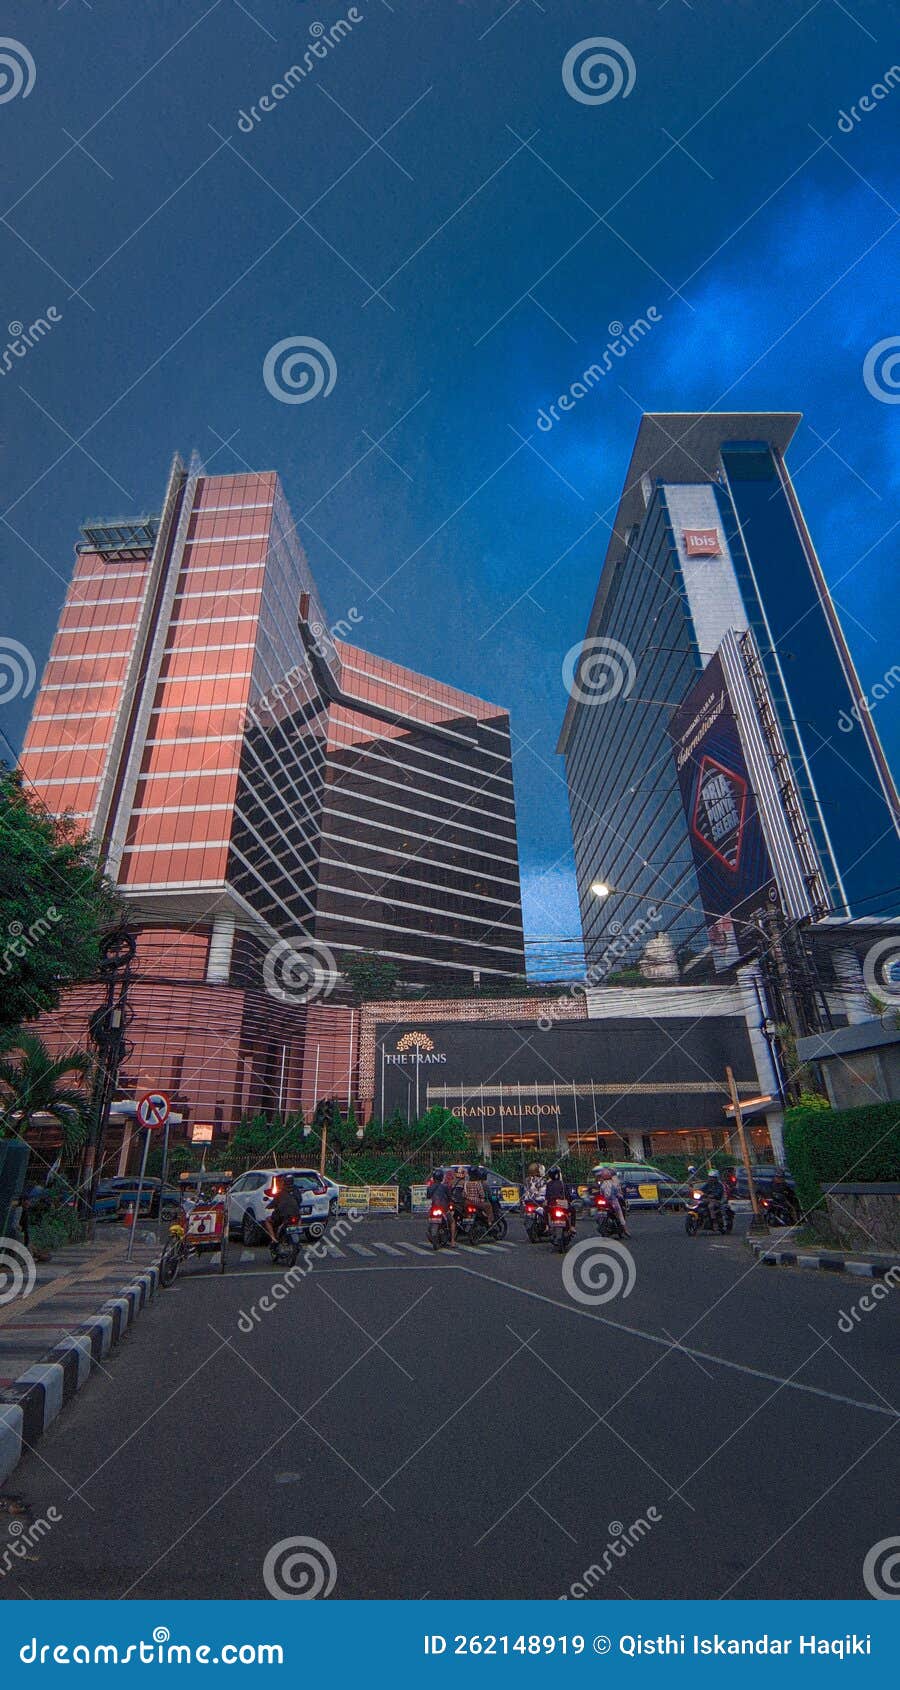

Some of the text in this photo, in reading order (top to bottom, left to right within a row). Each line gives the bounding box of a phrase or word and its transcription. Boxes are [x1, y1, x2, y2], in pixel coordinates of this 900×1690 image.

[690, 535, 716, 546] ibis
[384, 1053, 447, 1065] THE TRANS
[451, 1105, 496, 1117] GRAND
[500, 1104, 561, 1117] BALLROOM
